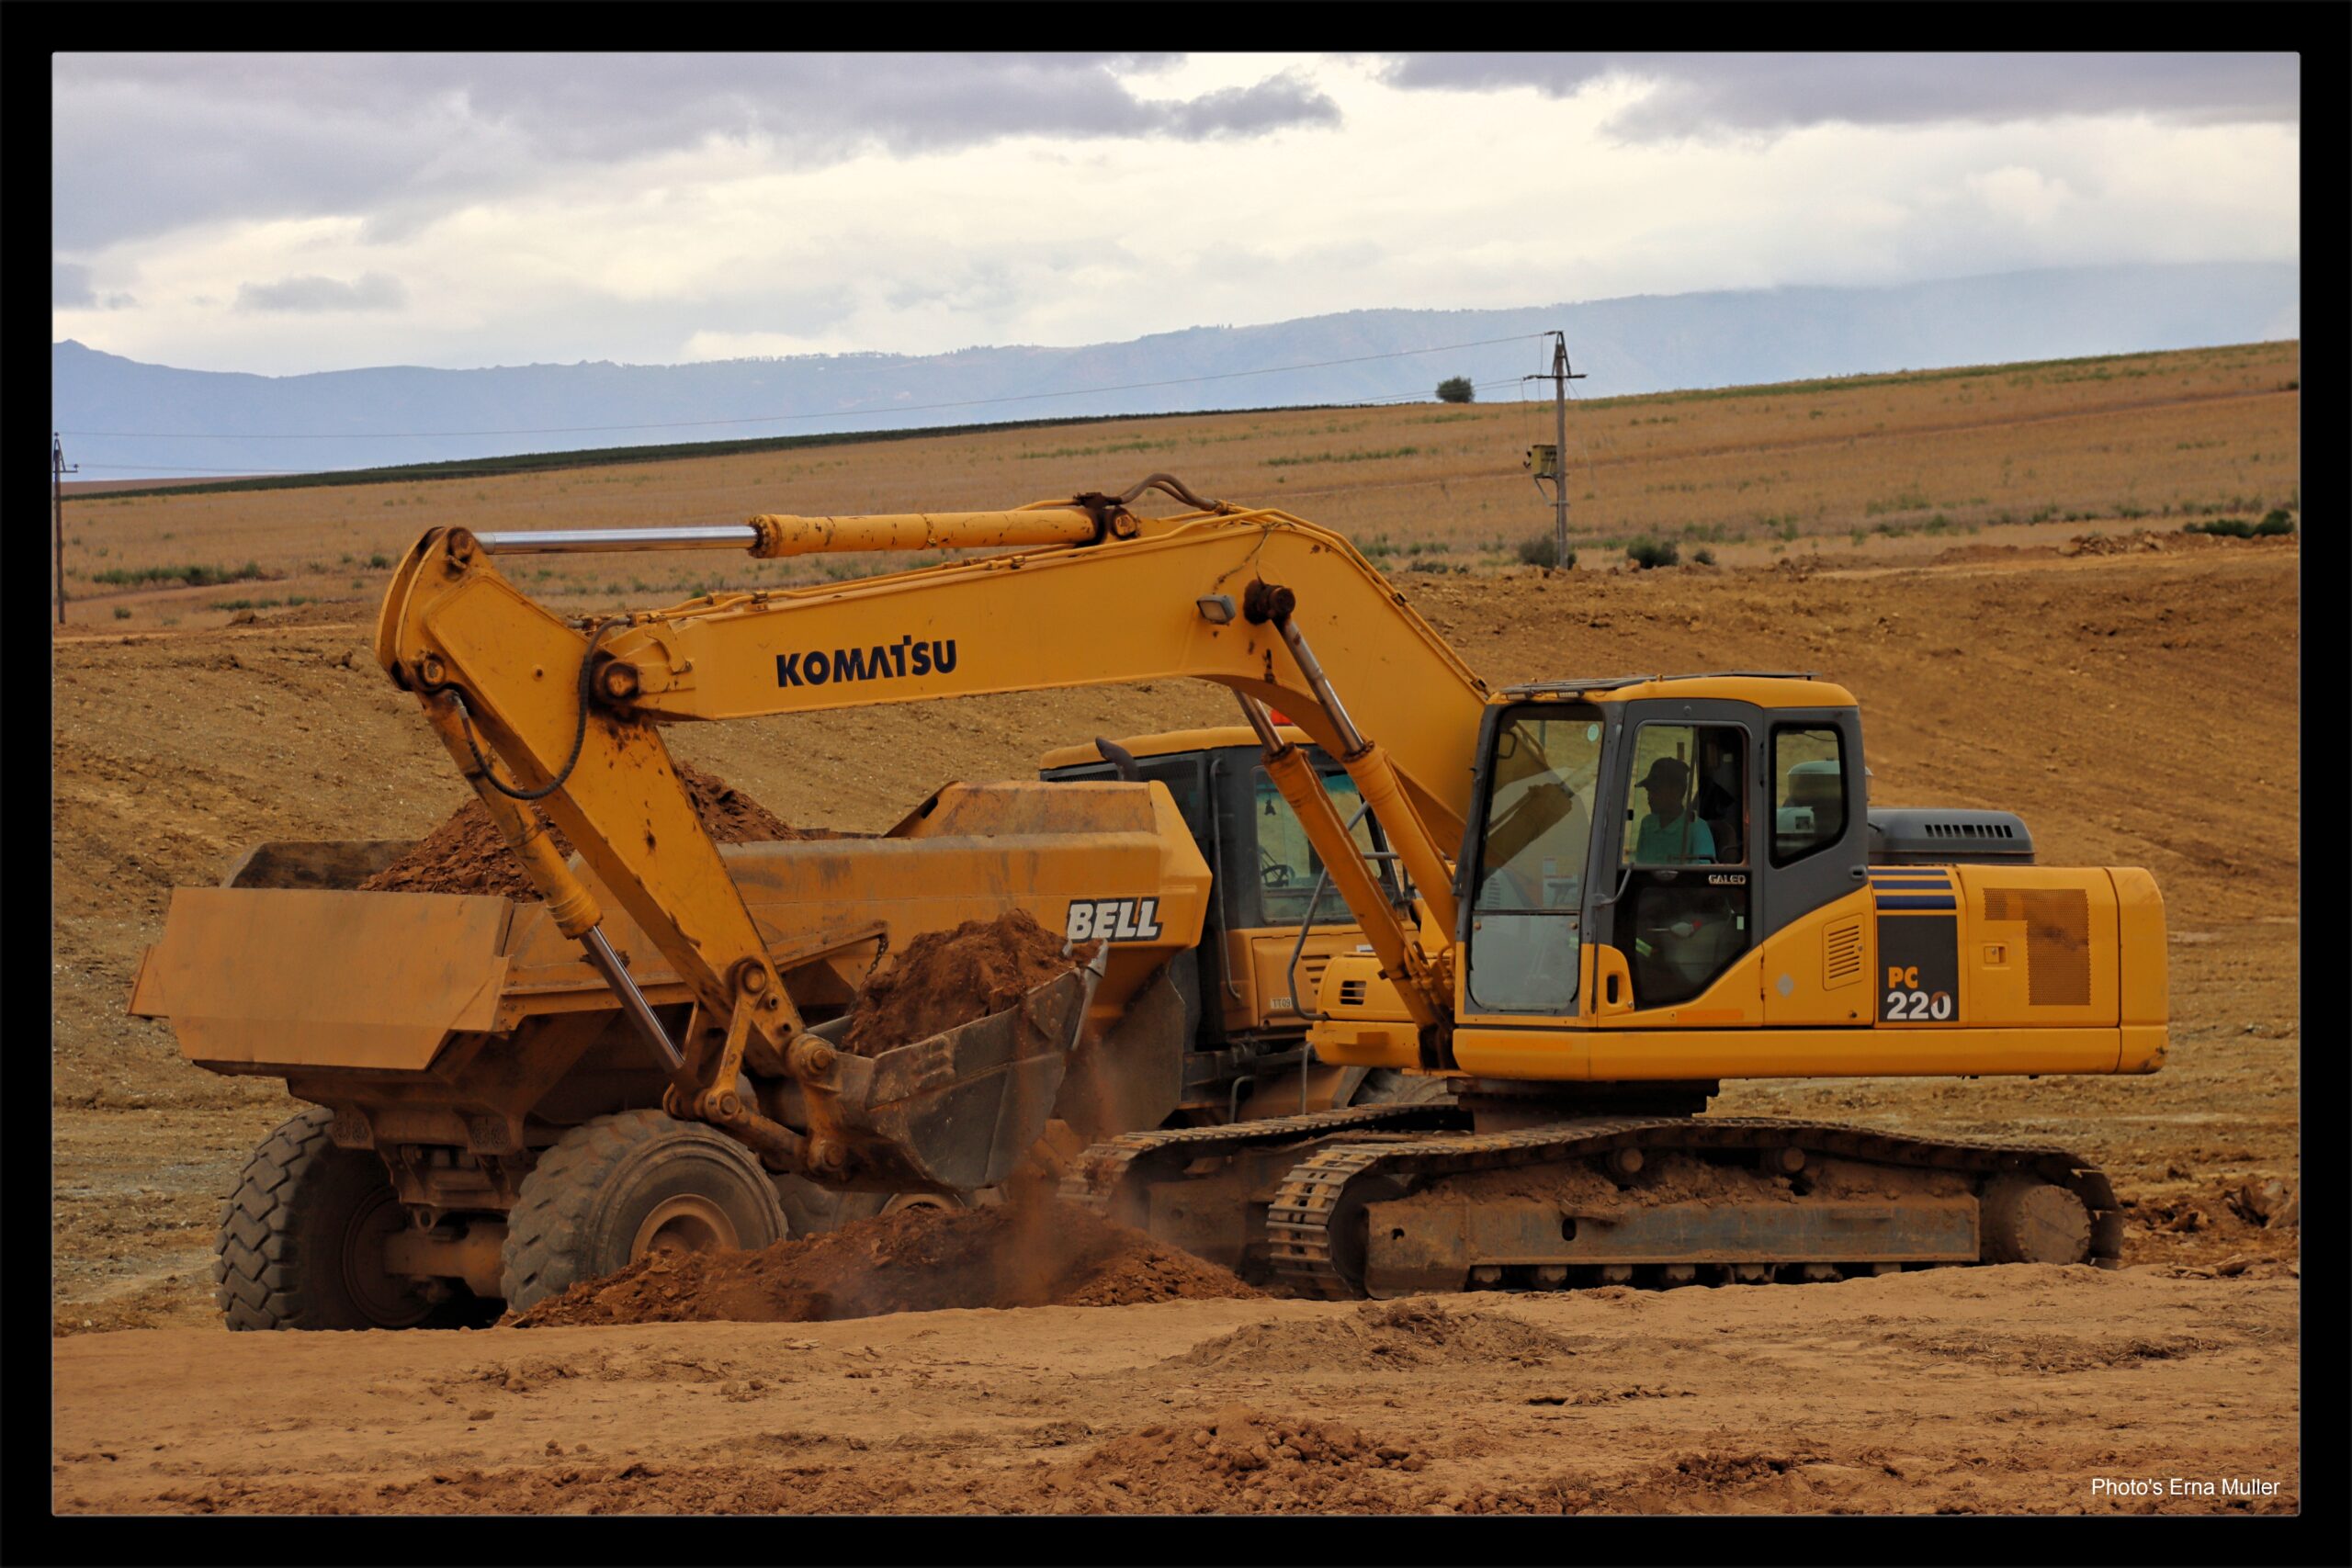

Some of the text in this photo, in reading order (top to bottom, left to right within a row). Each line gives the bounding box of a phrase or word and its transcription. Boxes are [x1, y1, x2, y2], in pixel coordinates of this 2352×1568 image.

[776, 635, 957, 688] KOMATSU
[1067, 899, 1159, 940] BELL
[1888, 966, 1918, 988] PC
[1886, 991, 1951, 1020] 220
